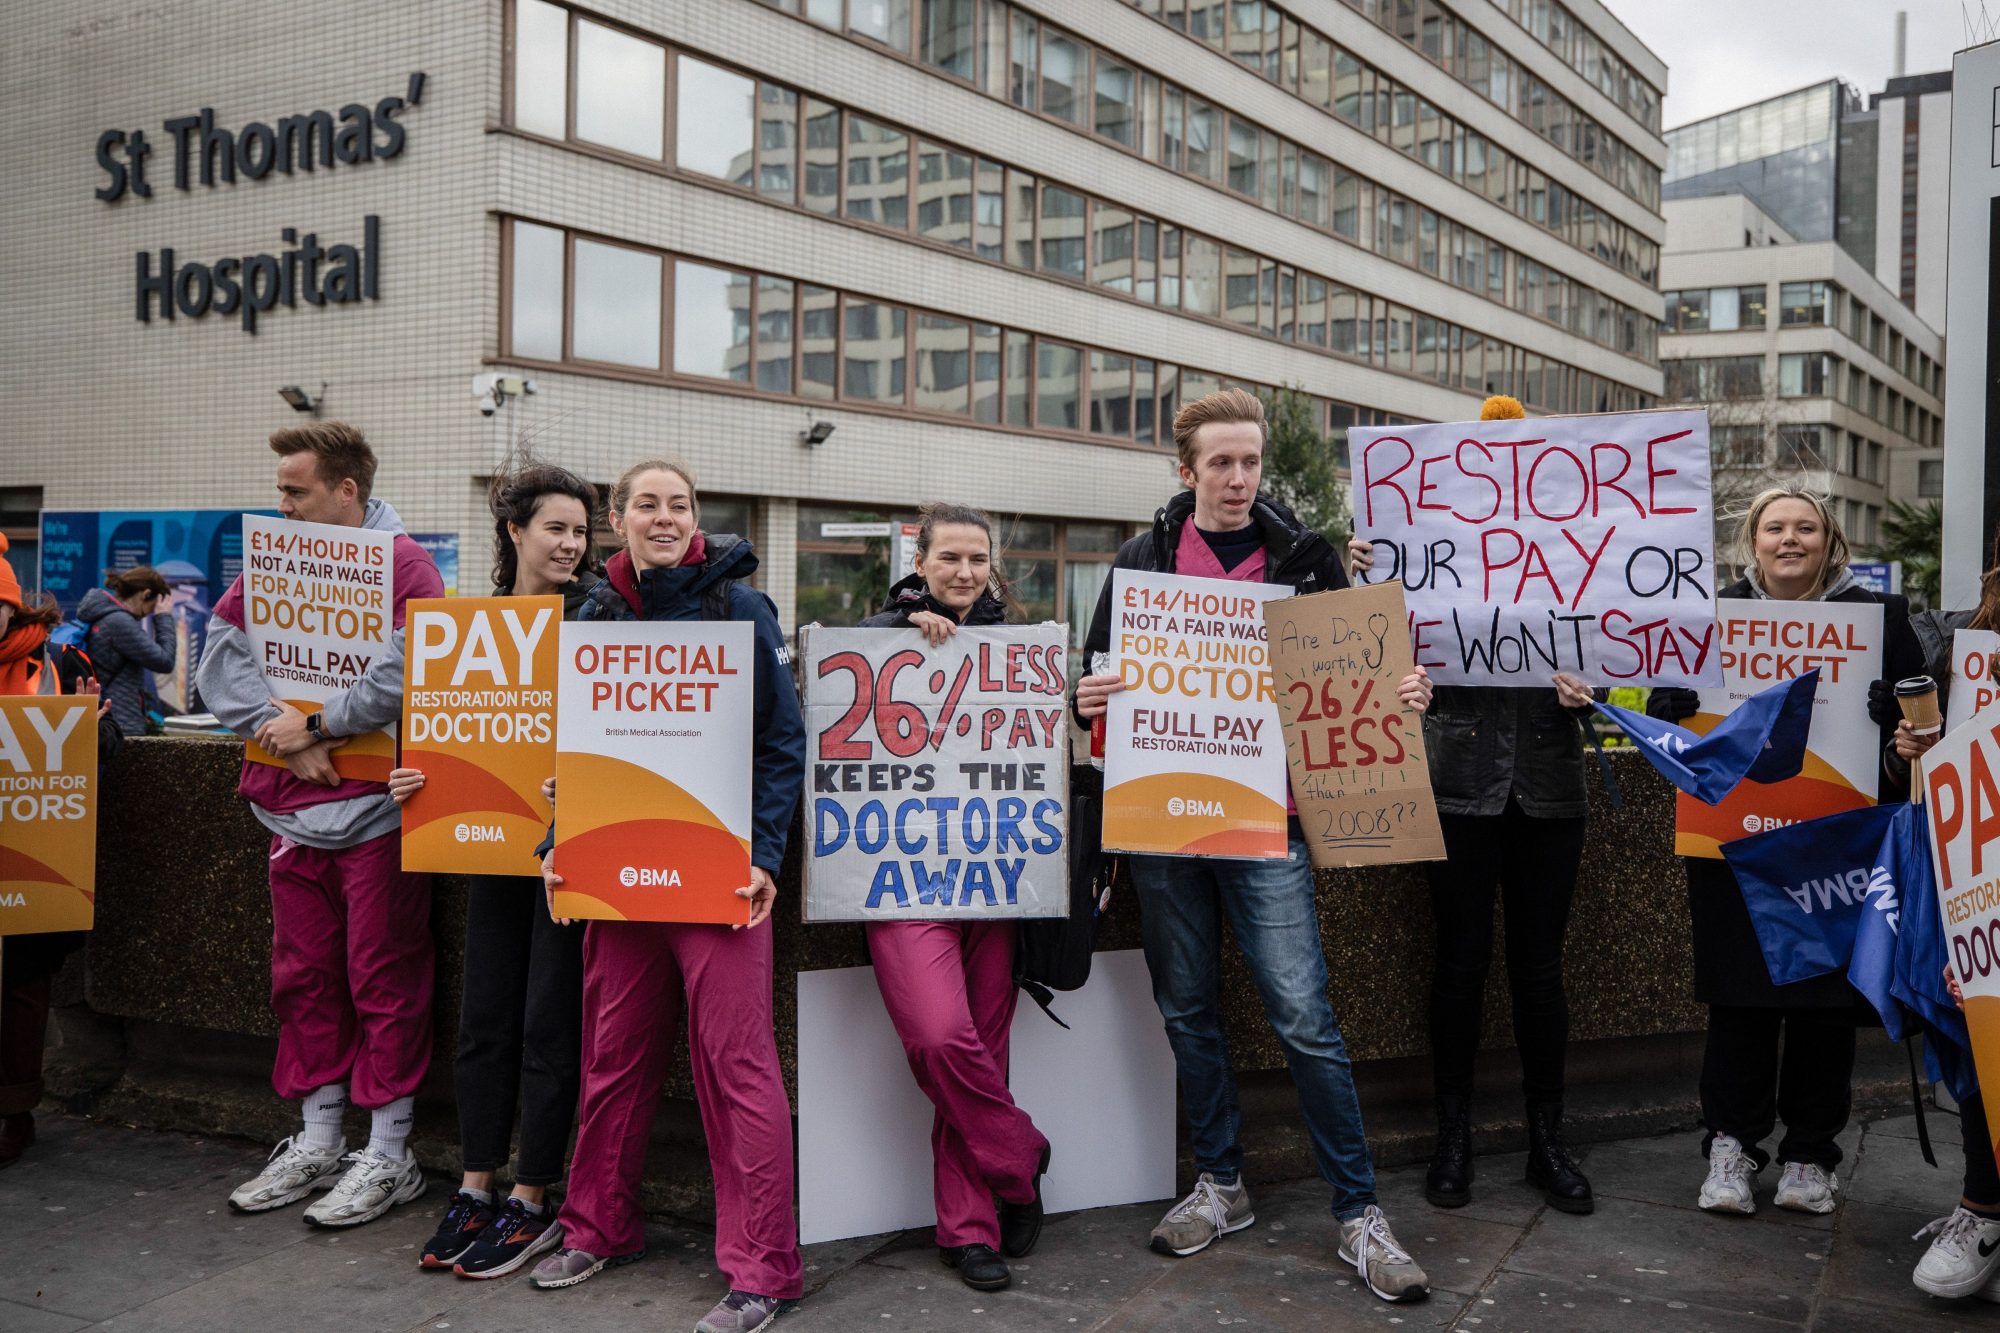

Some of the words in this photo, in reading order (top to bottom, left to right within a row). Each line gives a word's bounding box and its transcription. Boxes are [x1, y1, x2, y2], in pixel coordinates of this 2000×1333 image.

[95, 129, 152, 202] St
[135, 215, 380, 334] Hospital
[1364, 429, 1698, 527] RESTORE
[251, 530, 359, 563] £14/HOUR
[364, 545, 384, 567] IS
[251, 554, 282, 572] NOT
[285, 560, 297, 574] A
[300, 562, 333, 580] FAIR
[336, 566, 384, 586] WAGE
[1360, 538, 1462, 591] OUR
[1480, 525, 1616, 612] PAY
[1625, 545, 1710, 600] OR
[251, 573, 289, 596] FOR
[292, 580, 307, 599] A
[309, 582, 384, 609] JUNIOR
[1123, 586, 1256, 620] £14/HOUR
[251, 595, 384, 643] DOCTOR
[1122, 612, 1162, 632] NOT
[1165, 617, 1179, 634] A
[1184, 618, 1225, 638] FAIR
[1229, 622, 1268, 642] WAG
[1281, 620, 1320, 654] Are
[1332, 617, 1362, 646] Drs
[1718, 619, 1868, 651] FFICIAL
[265, 640, 321, 672] FULL
[327, 651, 372, 677] PAY
[411, 608, 553, 686] PAY
[574, 644, 738, 675] OFFICIAL
[1120, 633, 1168, 657] FOR
[1173, 639, 1191, 660] A
[1195, 640, 1272, 667] JUNIO
[1408, 610, 1447, 668] E
[1600, 608, 1714, 678] STAY
[266, 665, 339, 688] RESTORATION
[1119, 658, 1278, 704] DOCTOR
[1313, 655, 1357, 674] worth
[411, 690, 518, 707] RESTORATION
[521, 690, 552, 707] FOR
[592, 681, 719, 712] PICKET
[818, 649, 974, 760] 26%
[978, 642, 1065, 695] LESS
[1288, 677, 1381, 722] 26%
[410, 712, 552, 743] DOCTORS
[605, 728, 628, 736] British
[629, 728, 658, 737] Medical
[659, 728, 702, 737] Association
[981, 708, 1062, 751] PAY
[1132, 708, 1206, 739] FULL
[1213, 715, 1264, 742] PAY
[1132, 737, 1227, 756] RESTORATION
[1231, 743, 1263, 758] NOW
[1301, 713, 1405, 772] LESS
[49, 775, 87, 790] FOR
[814, 763, 936, 793] KEEPS
[959, 763, 1046, 791] THE
[1306, 776, 1345, 800] than
[1364, 783, 1377, 796] in
[1186, 799, 1225, 817] BMA
[1317, 802, 1417, 838] 2008??
[1764, 817, 1802, 832] BM
[1928, 723, 2000, 892] PA
[471, 825, 505, 842] BMA
[814, 796, 1063, 858] DOCTORS
[640, 867, 682, 887] BMA
[864, 858, 1026, 908] AWAY
